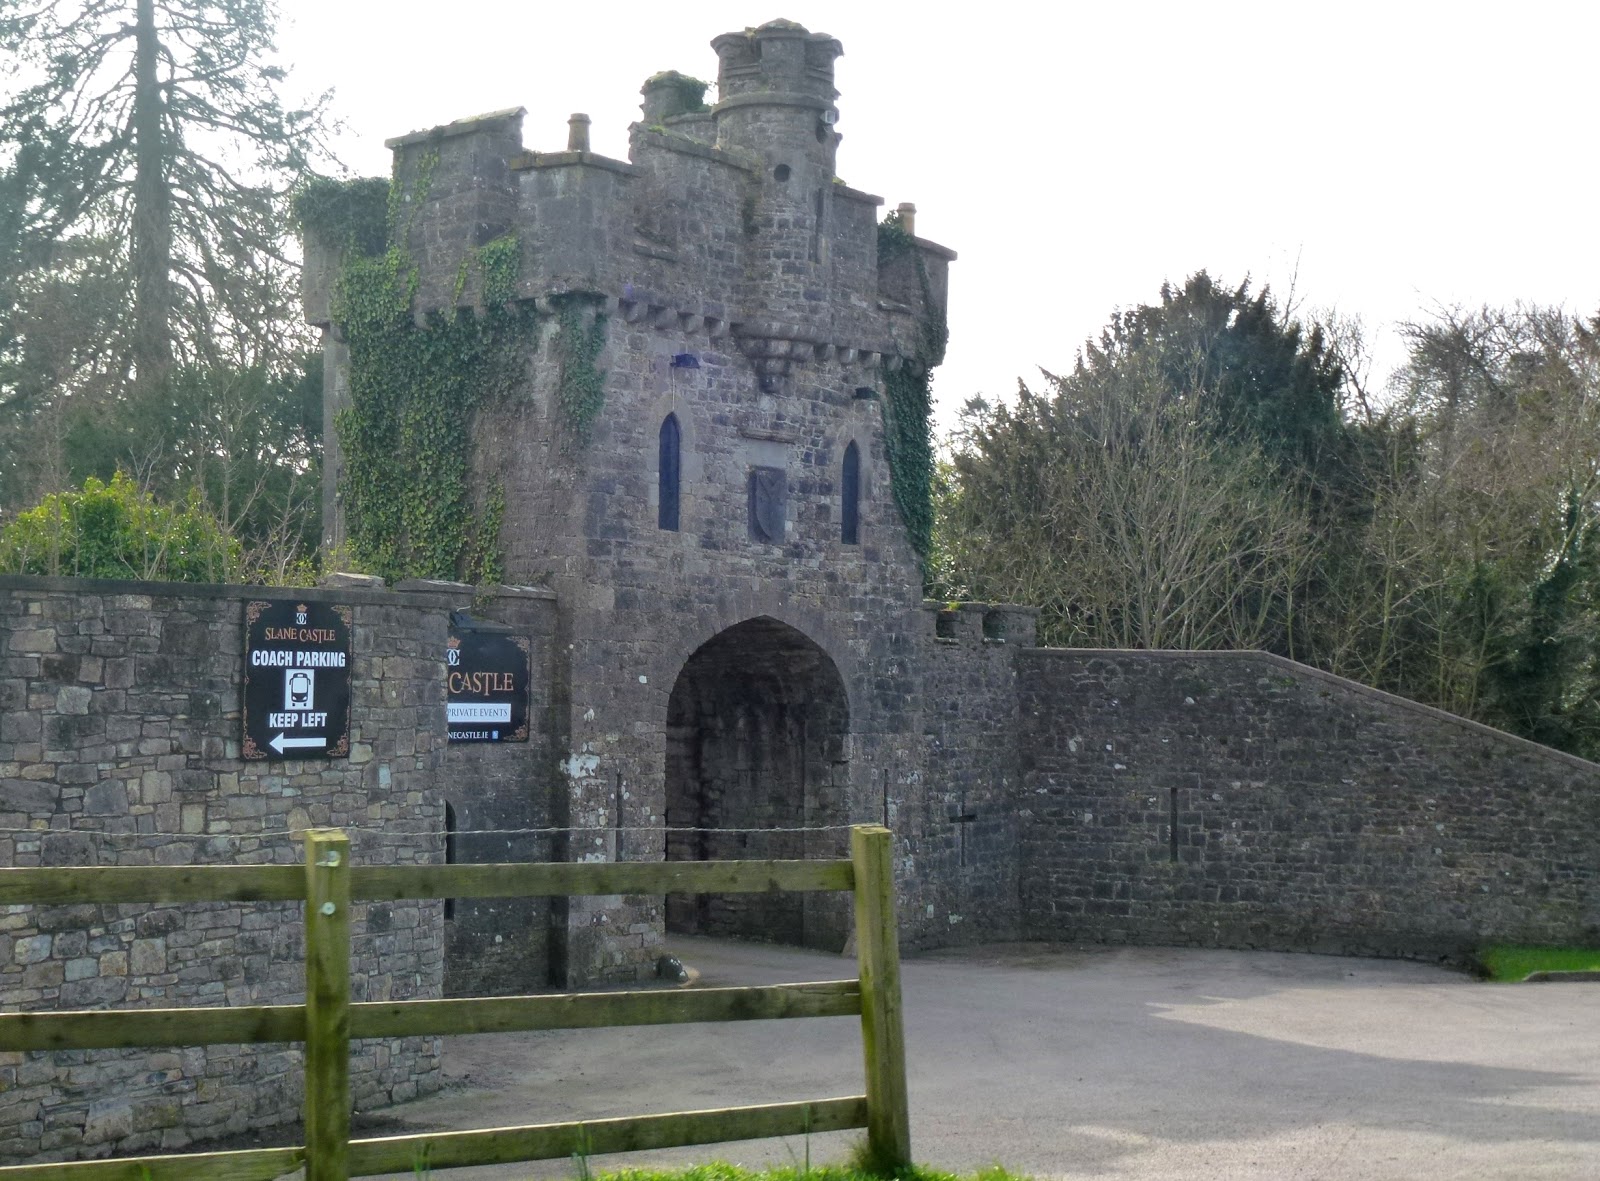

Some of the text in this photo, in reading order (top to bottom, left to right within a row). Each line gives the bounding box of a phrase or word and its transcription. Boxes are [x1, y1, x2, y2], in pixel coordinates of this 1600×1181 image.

[265, 627, 336, 643] SLANE CASTLE
[252, 650, 346, 667] COACH PARKING
[449, 672, 514, 696] CASTLE
[269, 712, 328, 728] KEEP LEFT
[448, 708, 508, 717] PRIVATE EVENTS
[448, 731, 488, 739] NECASTLE.IE
